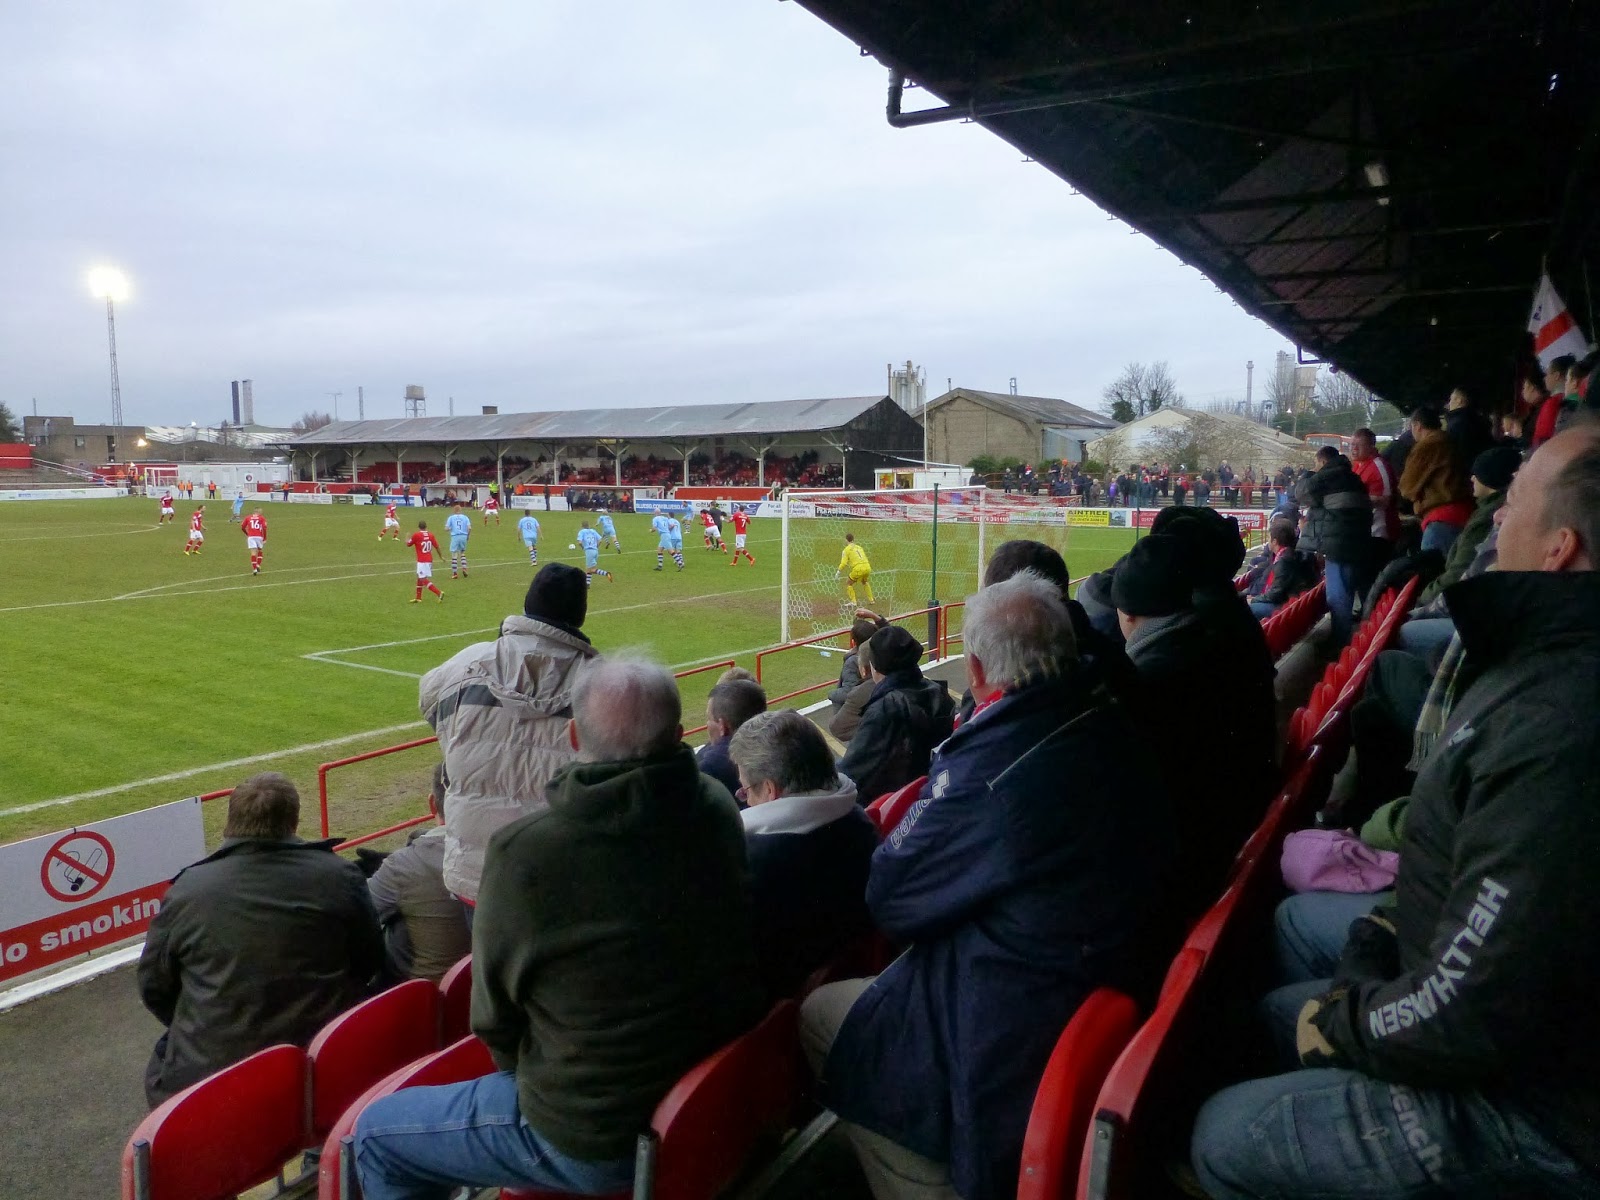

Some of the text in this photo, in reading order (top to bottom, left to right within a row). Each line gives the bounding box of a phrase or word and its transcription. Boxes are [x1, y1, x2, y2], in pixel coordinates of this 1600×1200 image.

[250, 519, 260, 529] 16
[456, 521, 462, 530] 5
[741, 518, 747, 527] 7
[421, 540, 432, 553] 20
[40, 898, 161, 951] smokin
